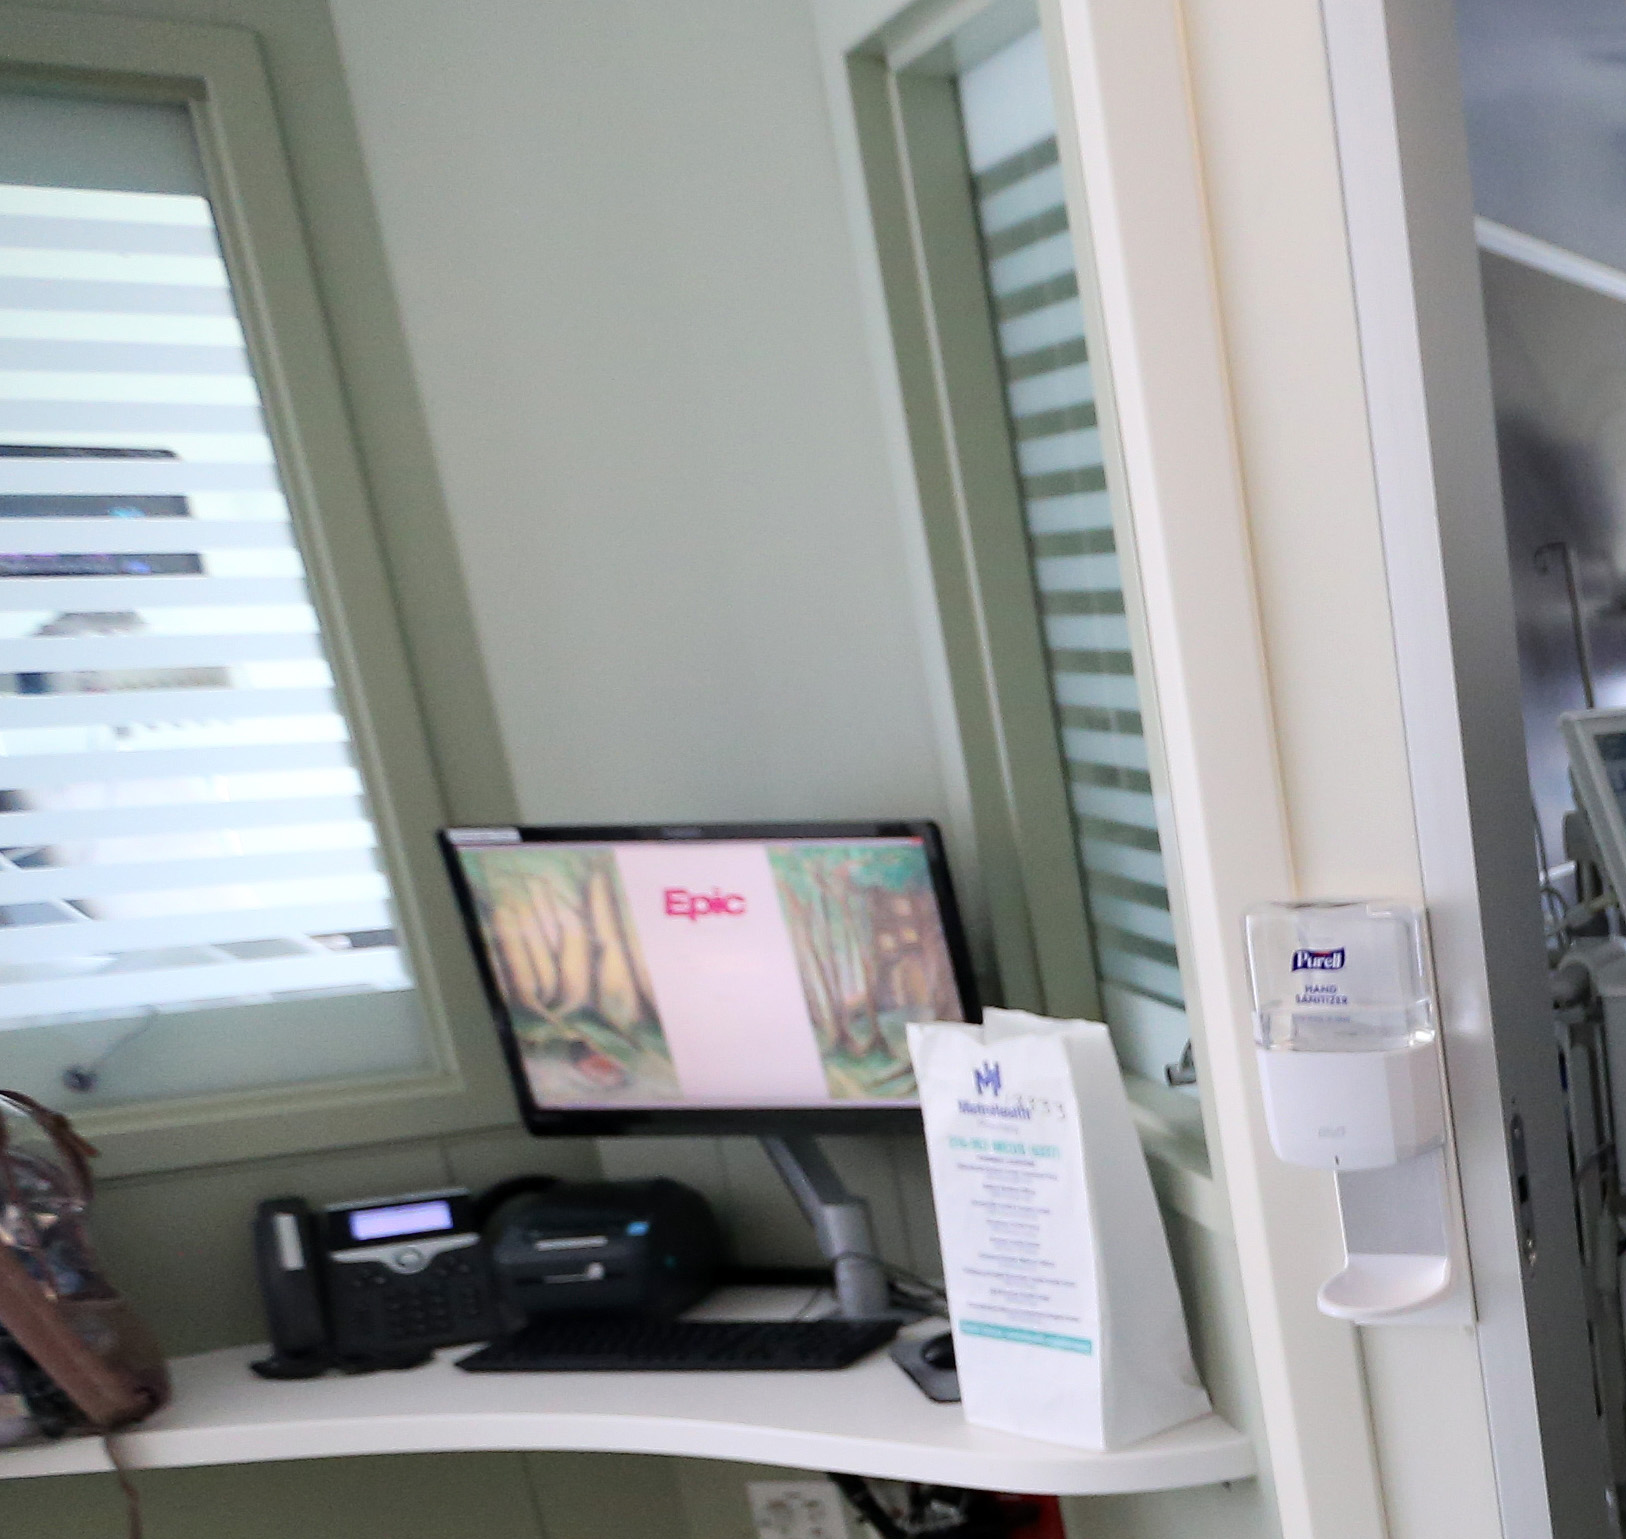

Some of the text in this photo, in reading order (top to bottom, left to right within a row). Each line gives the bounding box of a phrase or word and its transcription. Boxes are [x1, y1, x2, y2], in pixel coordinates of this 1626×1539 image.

[664, 887, 747, 922] Epic
[1305, 984, 1337, 994] HAND
[1295, 993, 1348, 1005] SANITIZER
